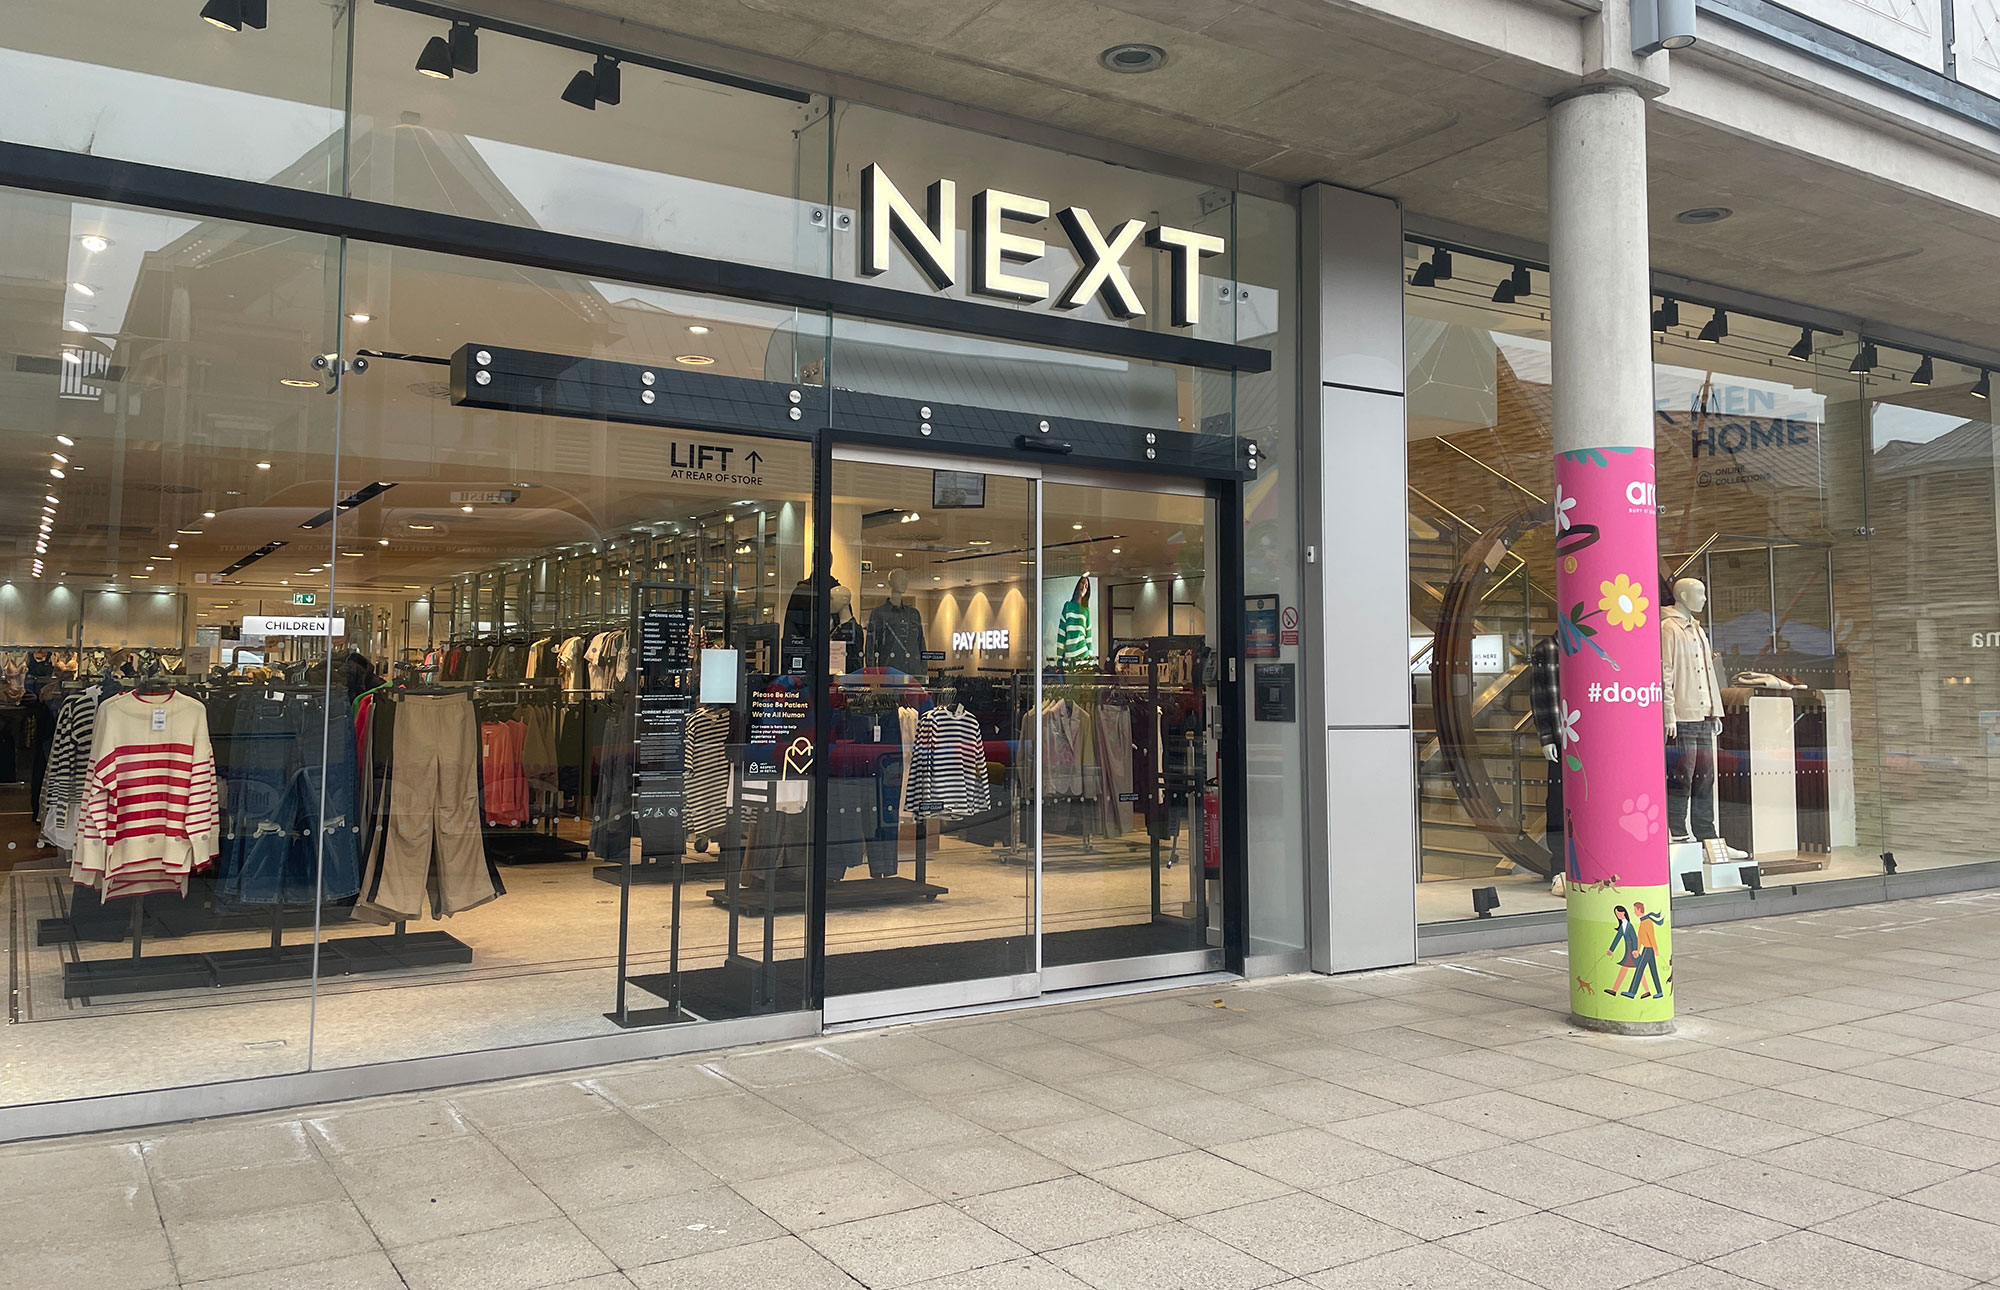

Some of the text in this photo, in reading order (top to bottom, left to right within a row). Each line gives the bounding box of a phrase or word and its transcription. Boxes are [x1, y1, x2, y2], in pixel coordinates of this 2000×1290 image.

[861, 162, 1225, 328] NEXT
[1691, 385, 1775, 421] MEN
[1691, 412, 1809, 459] HOME
[670, 442, 734, 471] LIFT
[670, 470, 763, 486] AT REAR OF STORE
[1715, 465, 1745, 476] ONLINE
[1715, 472, 1772, 486] COLLECTIONS
[1625, 481, 1656, 506] ar
[265, 621, 325, 631] CHILDREN
[952, 629, 1009, 651] PAY HERE
[1262, 666, 1286, 675] NEXT
[784, 691, 800, 699] Kind
